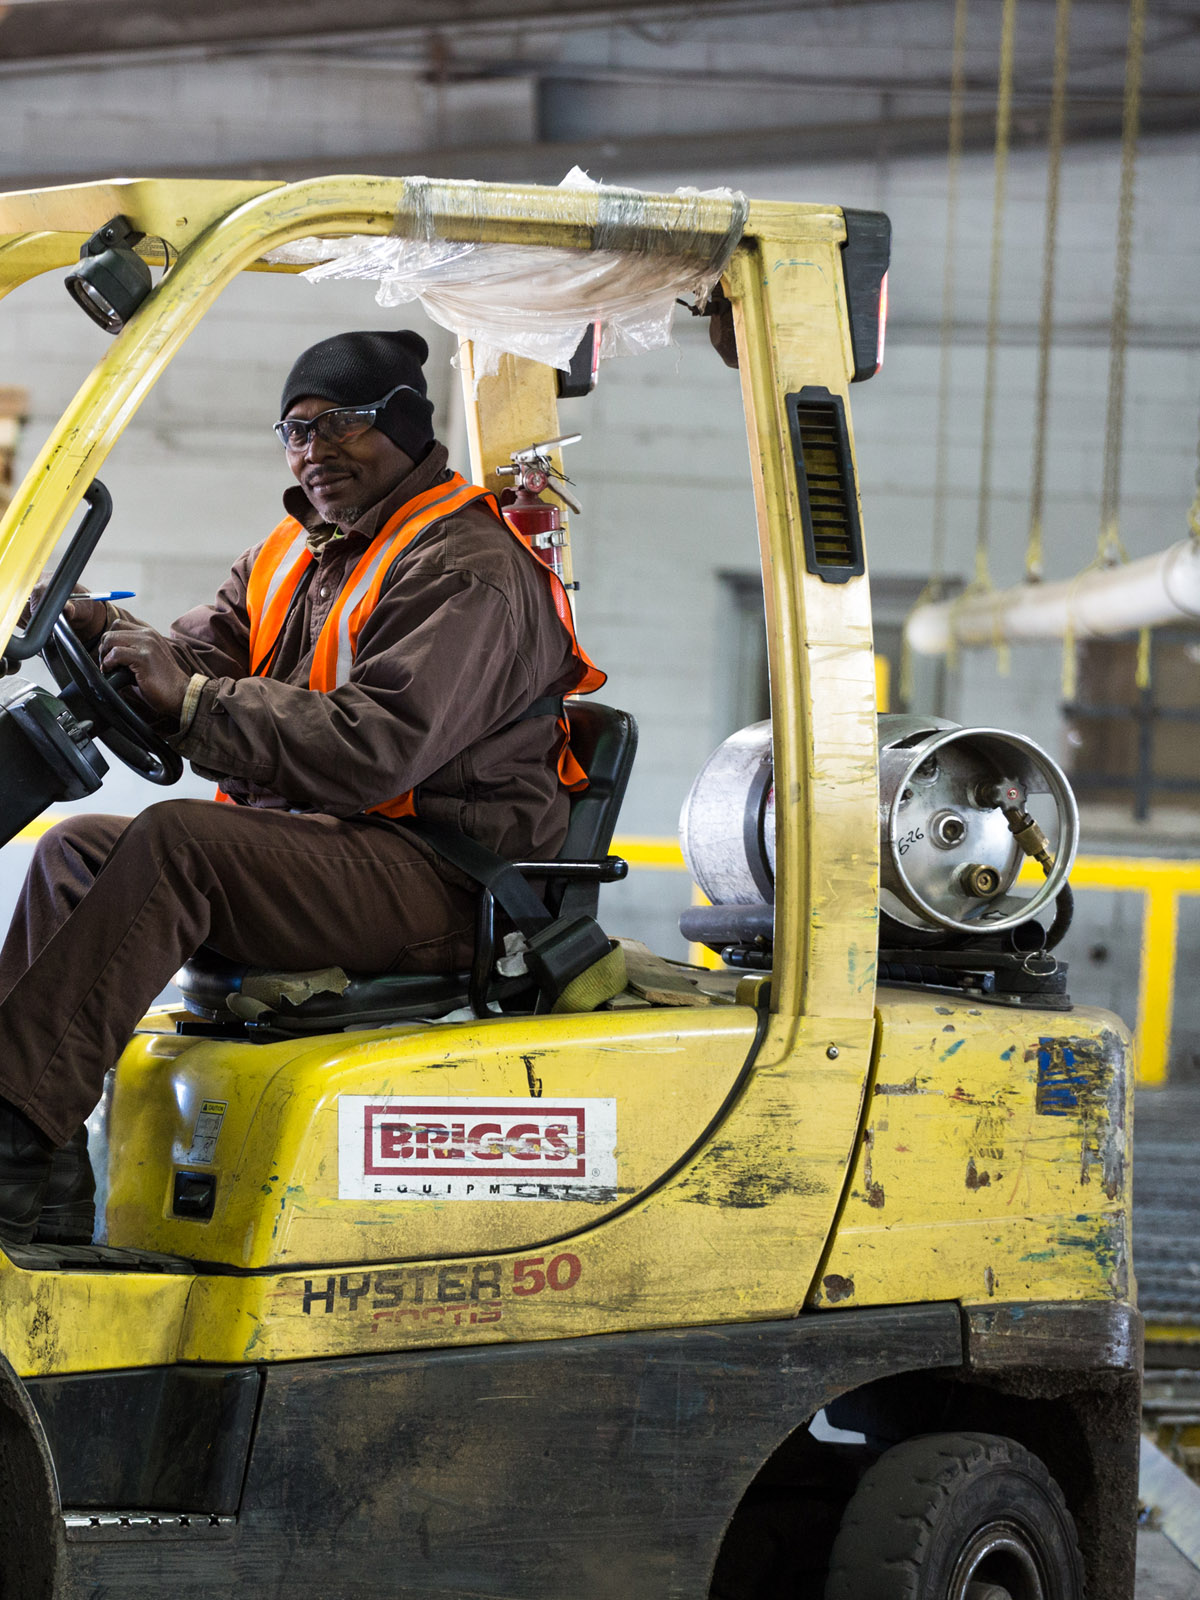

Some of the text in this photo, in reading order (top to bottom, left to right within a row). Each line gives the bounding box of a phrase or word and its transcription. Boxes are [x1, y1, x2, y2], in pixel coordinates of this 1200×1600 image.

[380, 1122, 569, 1162] BRIGGS
[374, 1183, 572, 1195] EQUIPMENT
[302, 1252, 582, 1315] HYSTER 50
